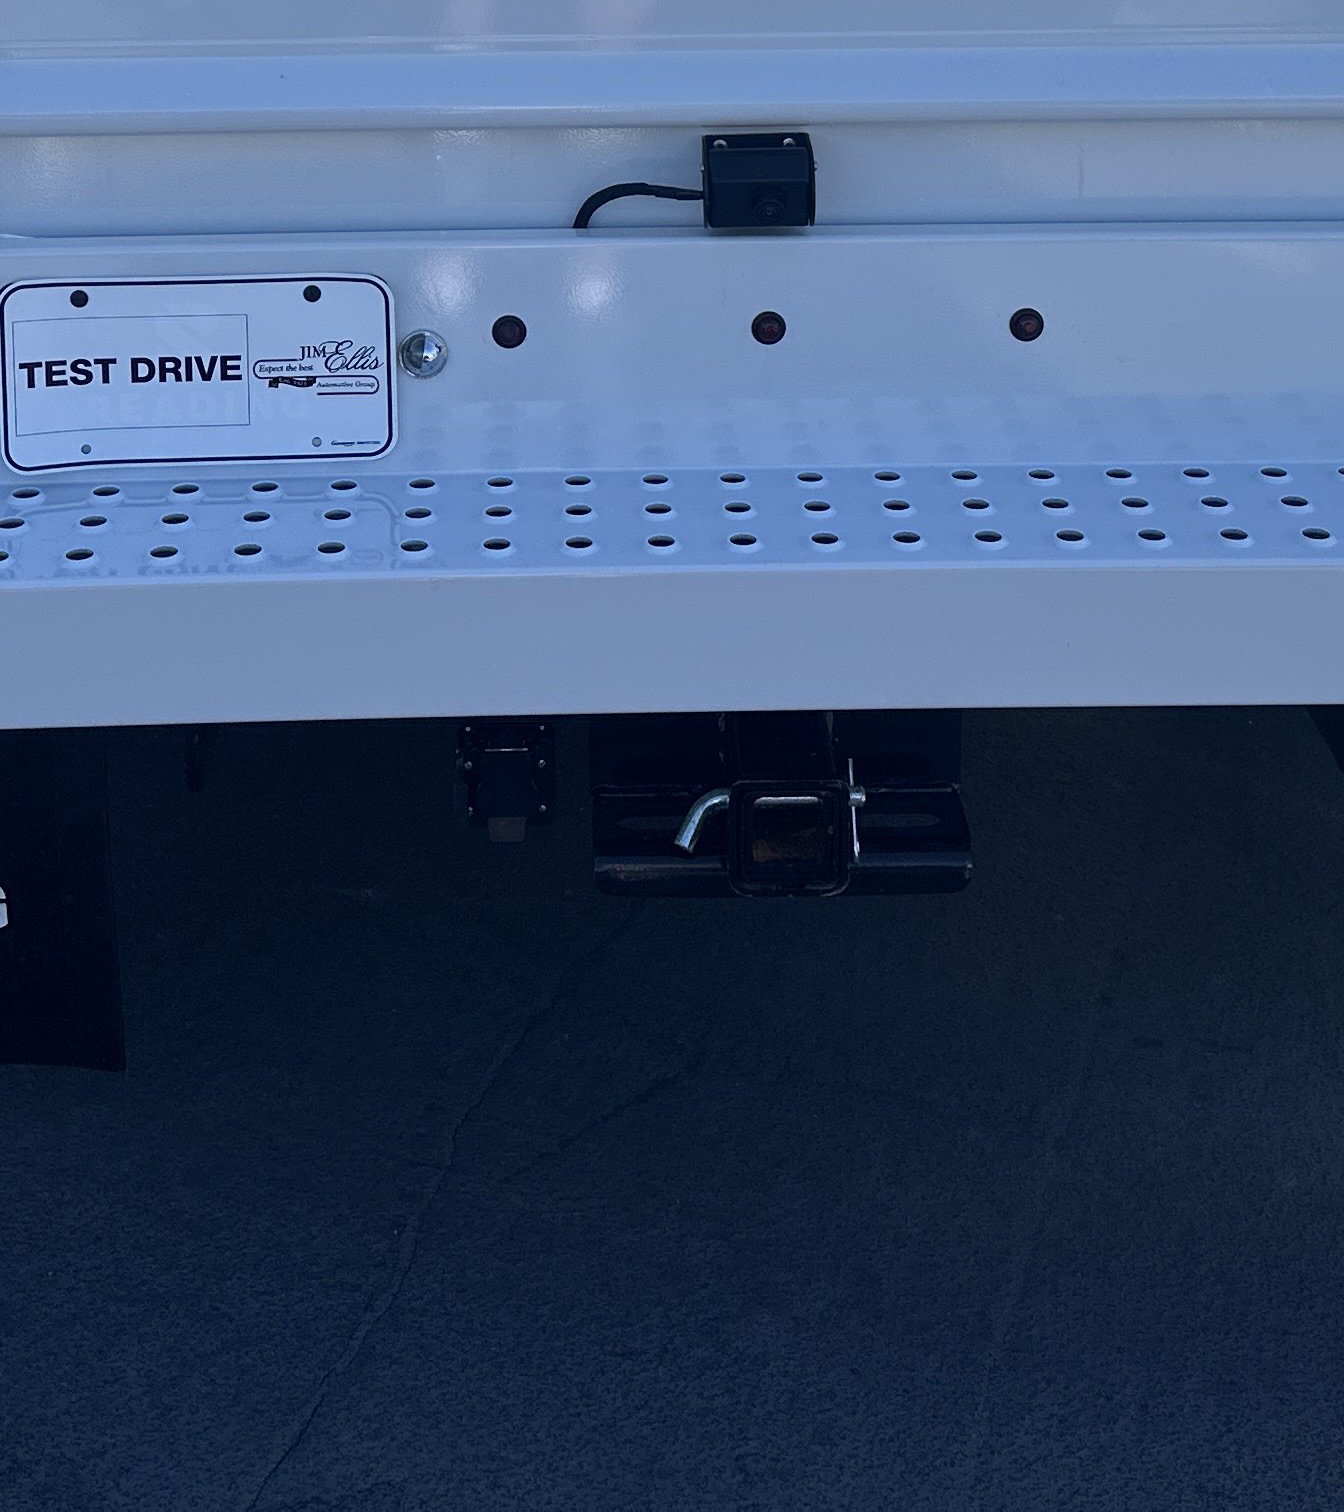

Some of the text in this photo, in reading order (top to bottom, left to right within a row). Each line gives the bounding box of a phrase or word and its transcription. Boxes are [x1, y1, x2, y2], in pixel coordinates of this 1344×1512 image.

[18, 354, 243, 389] TEST DRIVE
[299, 340, 384, 374] JIM Ellis
